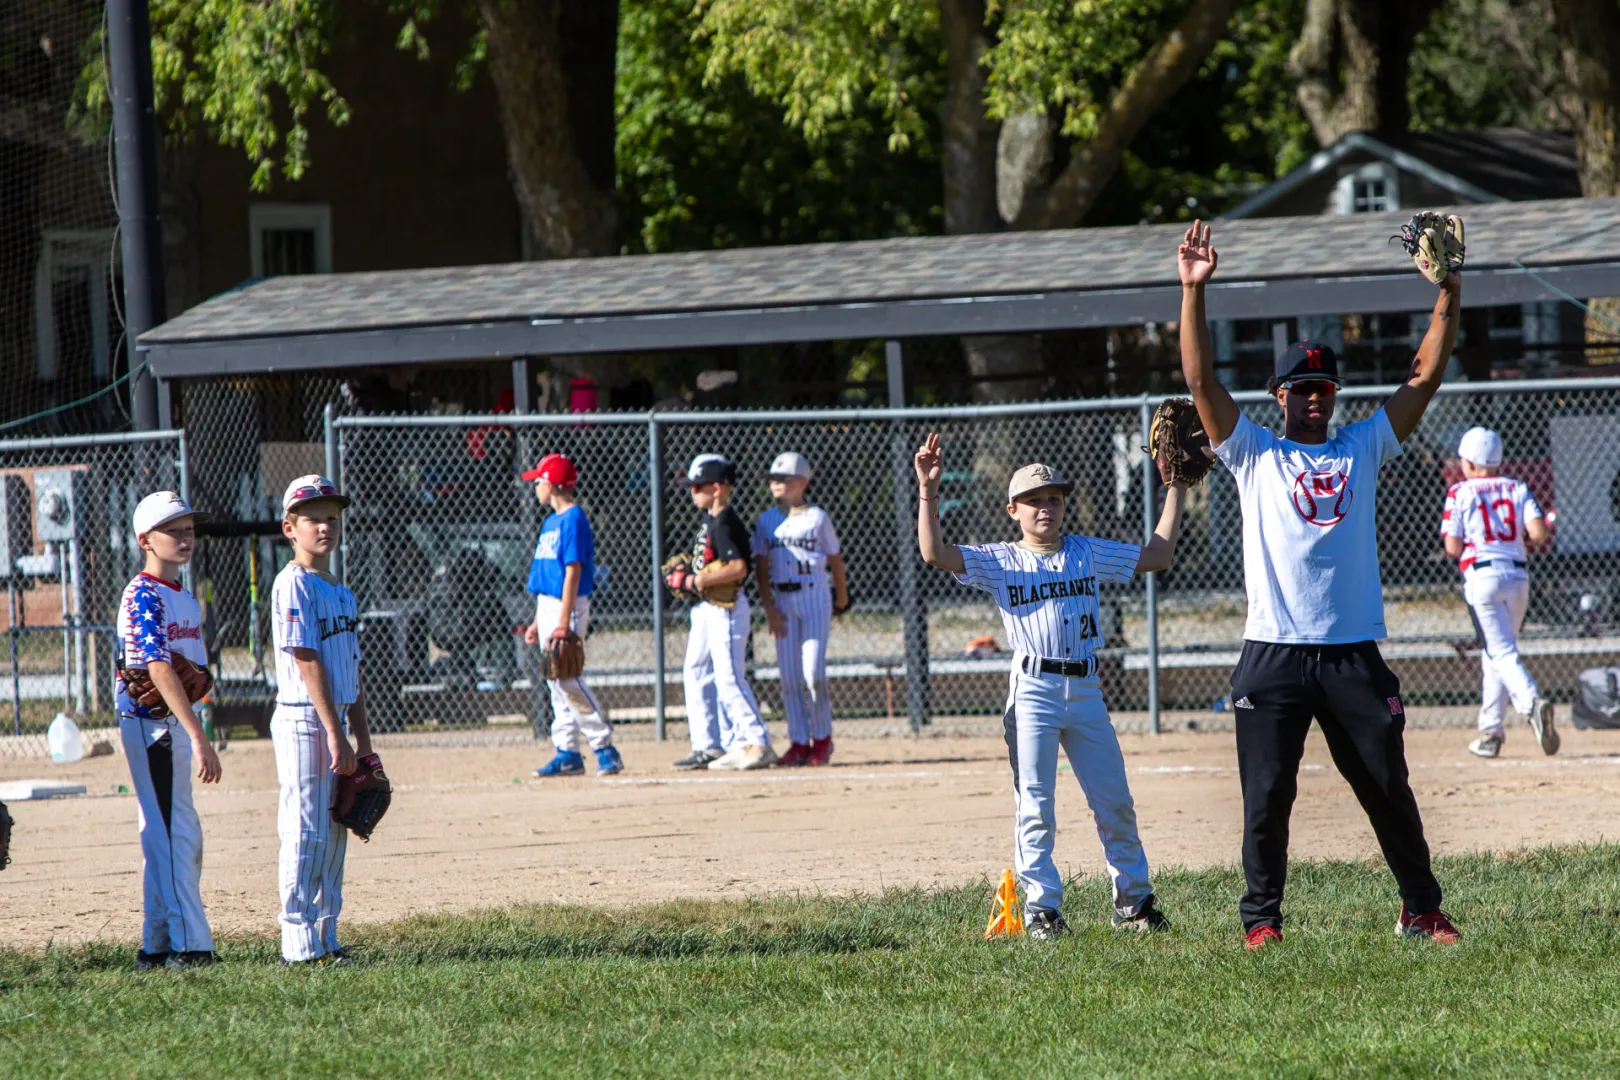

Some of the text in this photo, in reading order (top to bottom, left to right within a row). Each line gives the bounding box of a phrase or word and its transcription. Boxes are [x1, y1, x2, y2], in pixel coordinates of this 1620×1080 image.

[1306, 349, 1322, 369] N
[1312, 476, 1336, 496] N
[1478, 498, 1517, 543] 13
[1006, 576, 1096, 608] BLACKHAWKS
[1387, 696, 1402, 715] N
